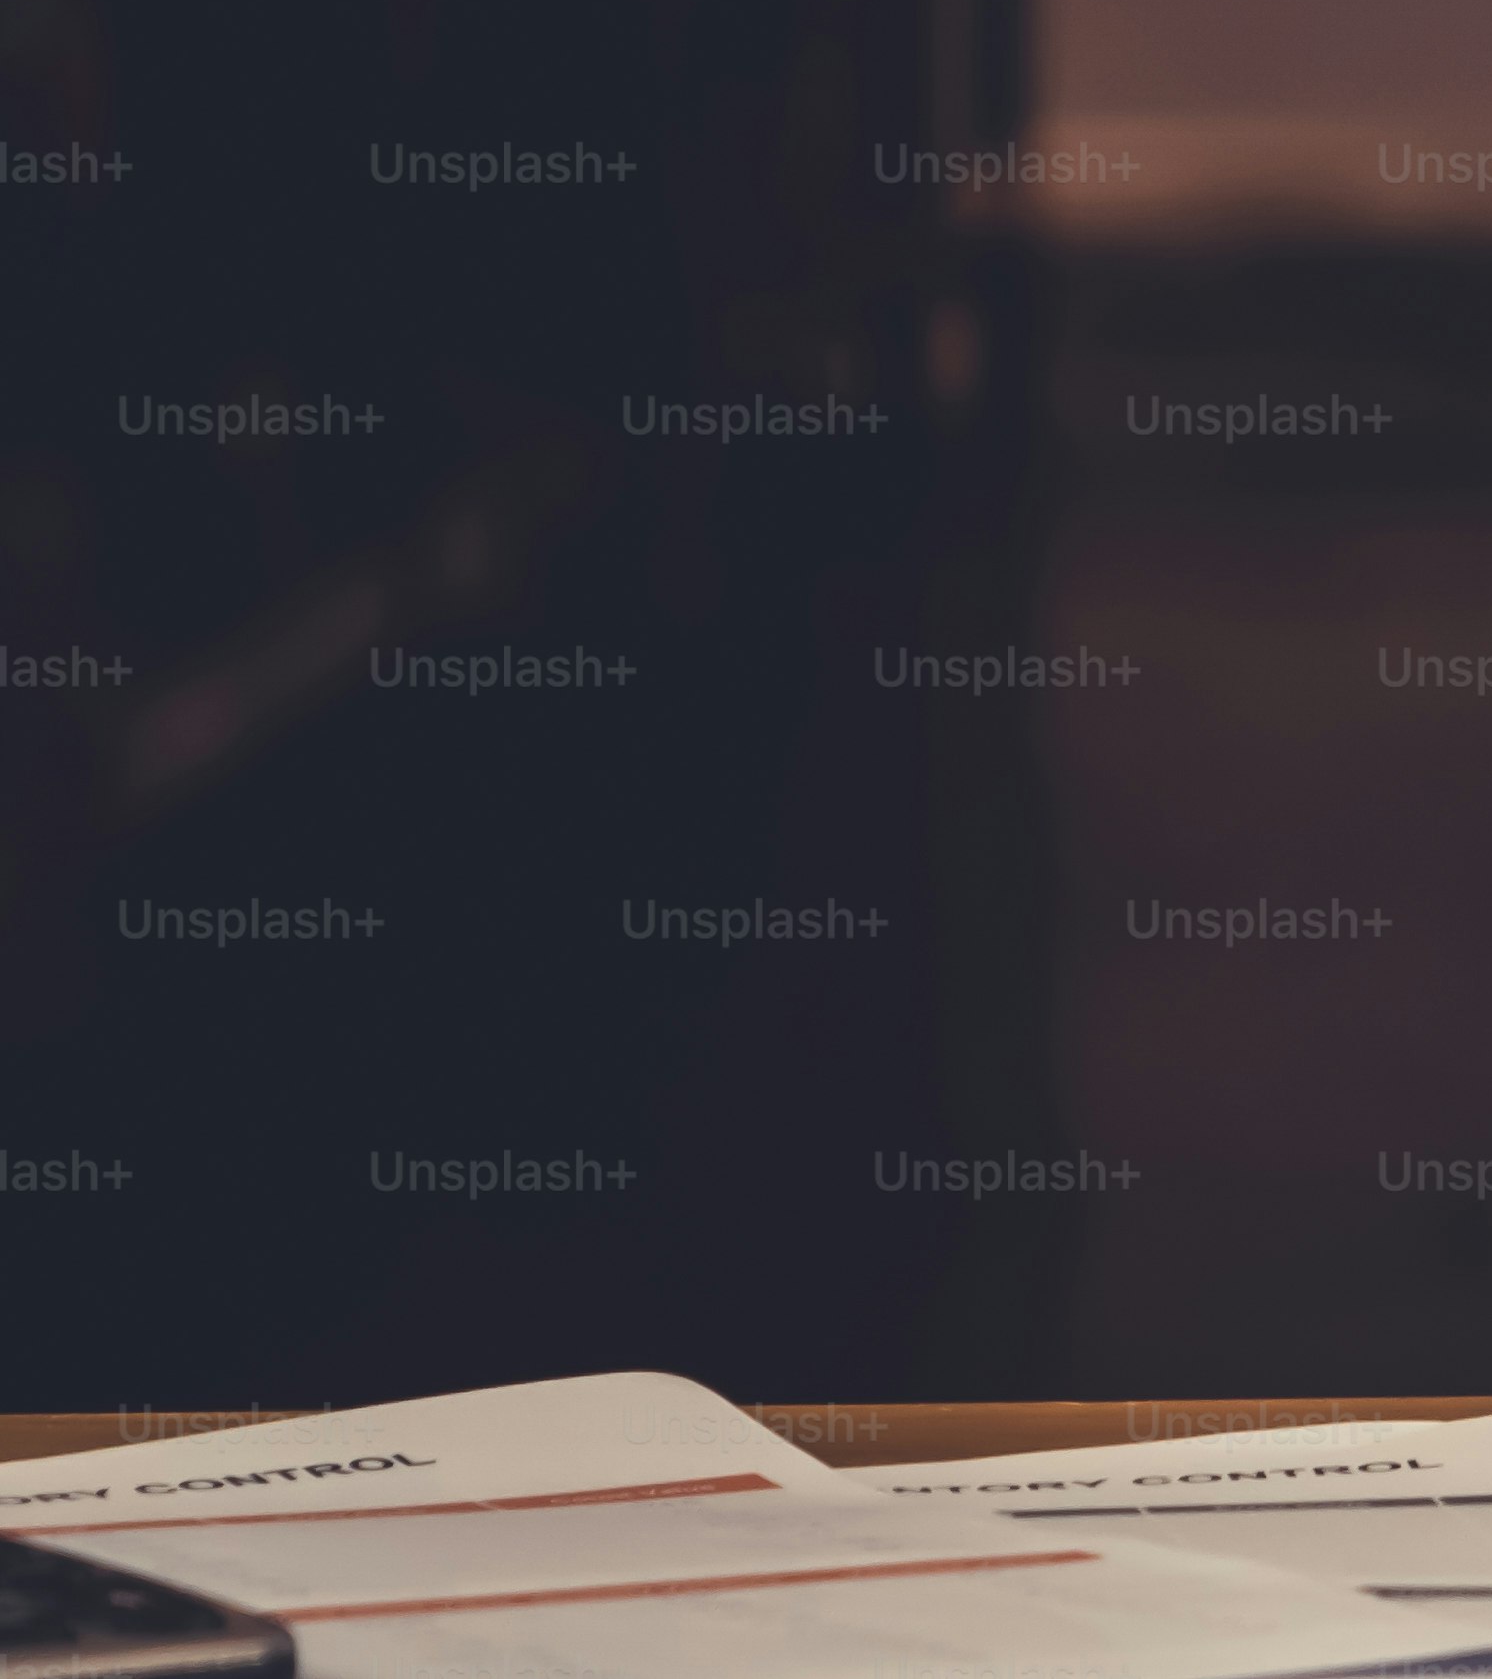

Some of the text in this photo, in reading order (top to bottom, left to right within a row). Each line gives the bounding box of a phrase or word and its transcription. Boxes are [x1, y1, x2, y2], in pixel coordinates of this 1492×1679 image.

[134, 1454, 436, 1495] CONTROL
[888, 1458, 1444, 1494] NTORY CONTROL
